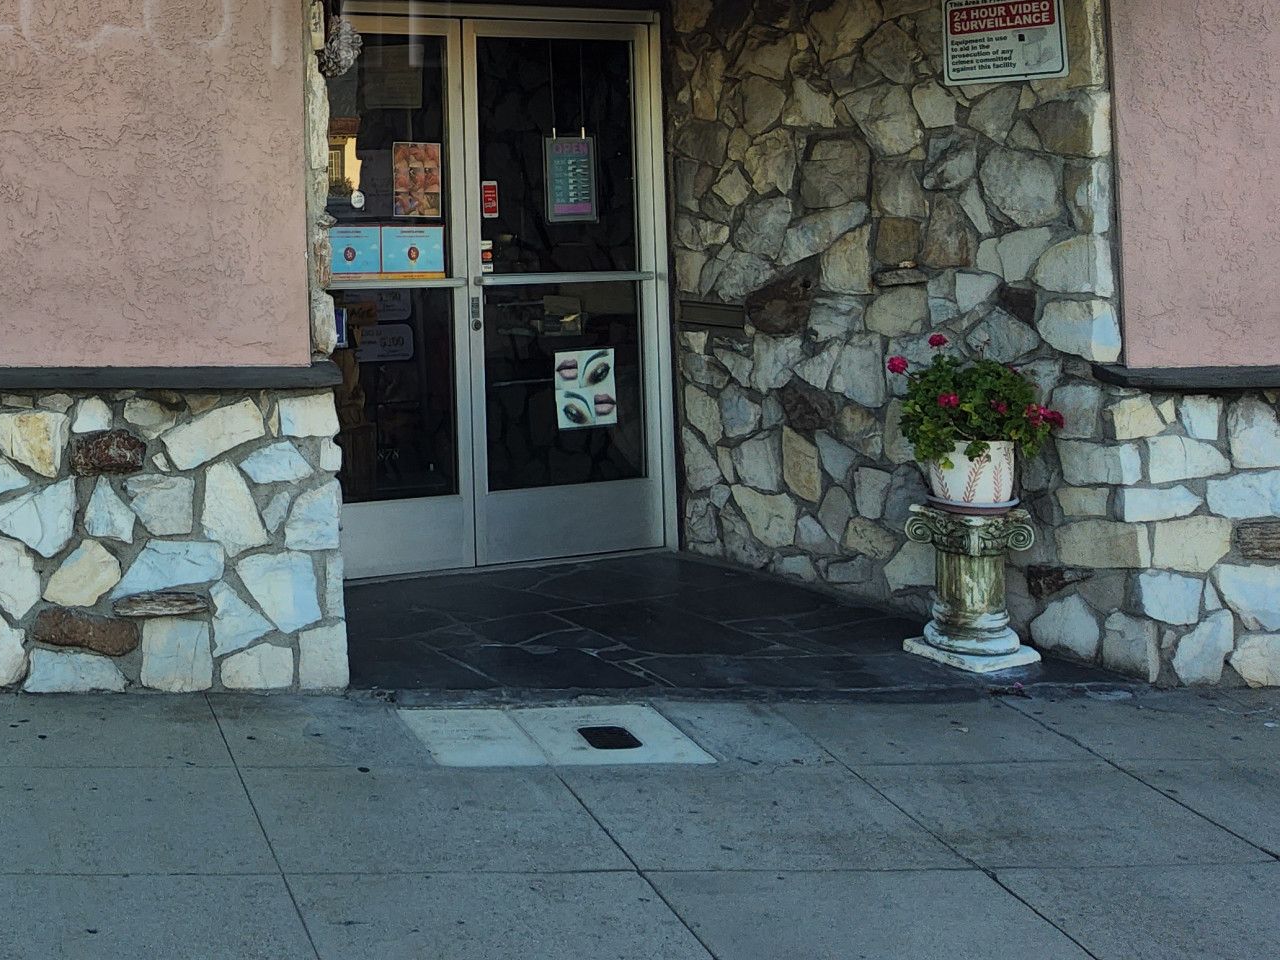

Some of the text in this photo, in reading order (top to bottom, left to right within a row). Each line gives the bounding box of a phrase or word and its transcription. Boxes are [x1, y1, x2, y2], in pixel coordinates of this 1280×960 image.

[954, 1, 1050, 21] 24 HOUR VIDEO
[954, 12, 1050, 32] SURVEILLANCE
[952, 51, 990, 59] prosecution
